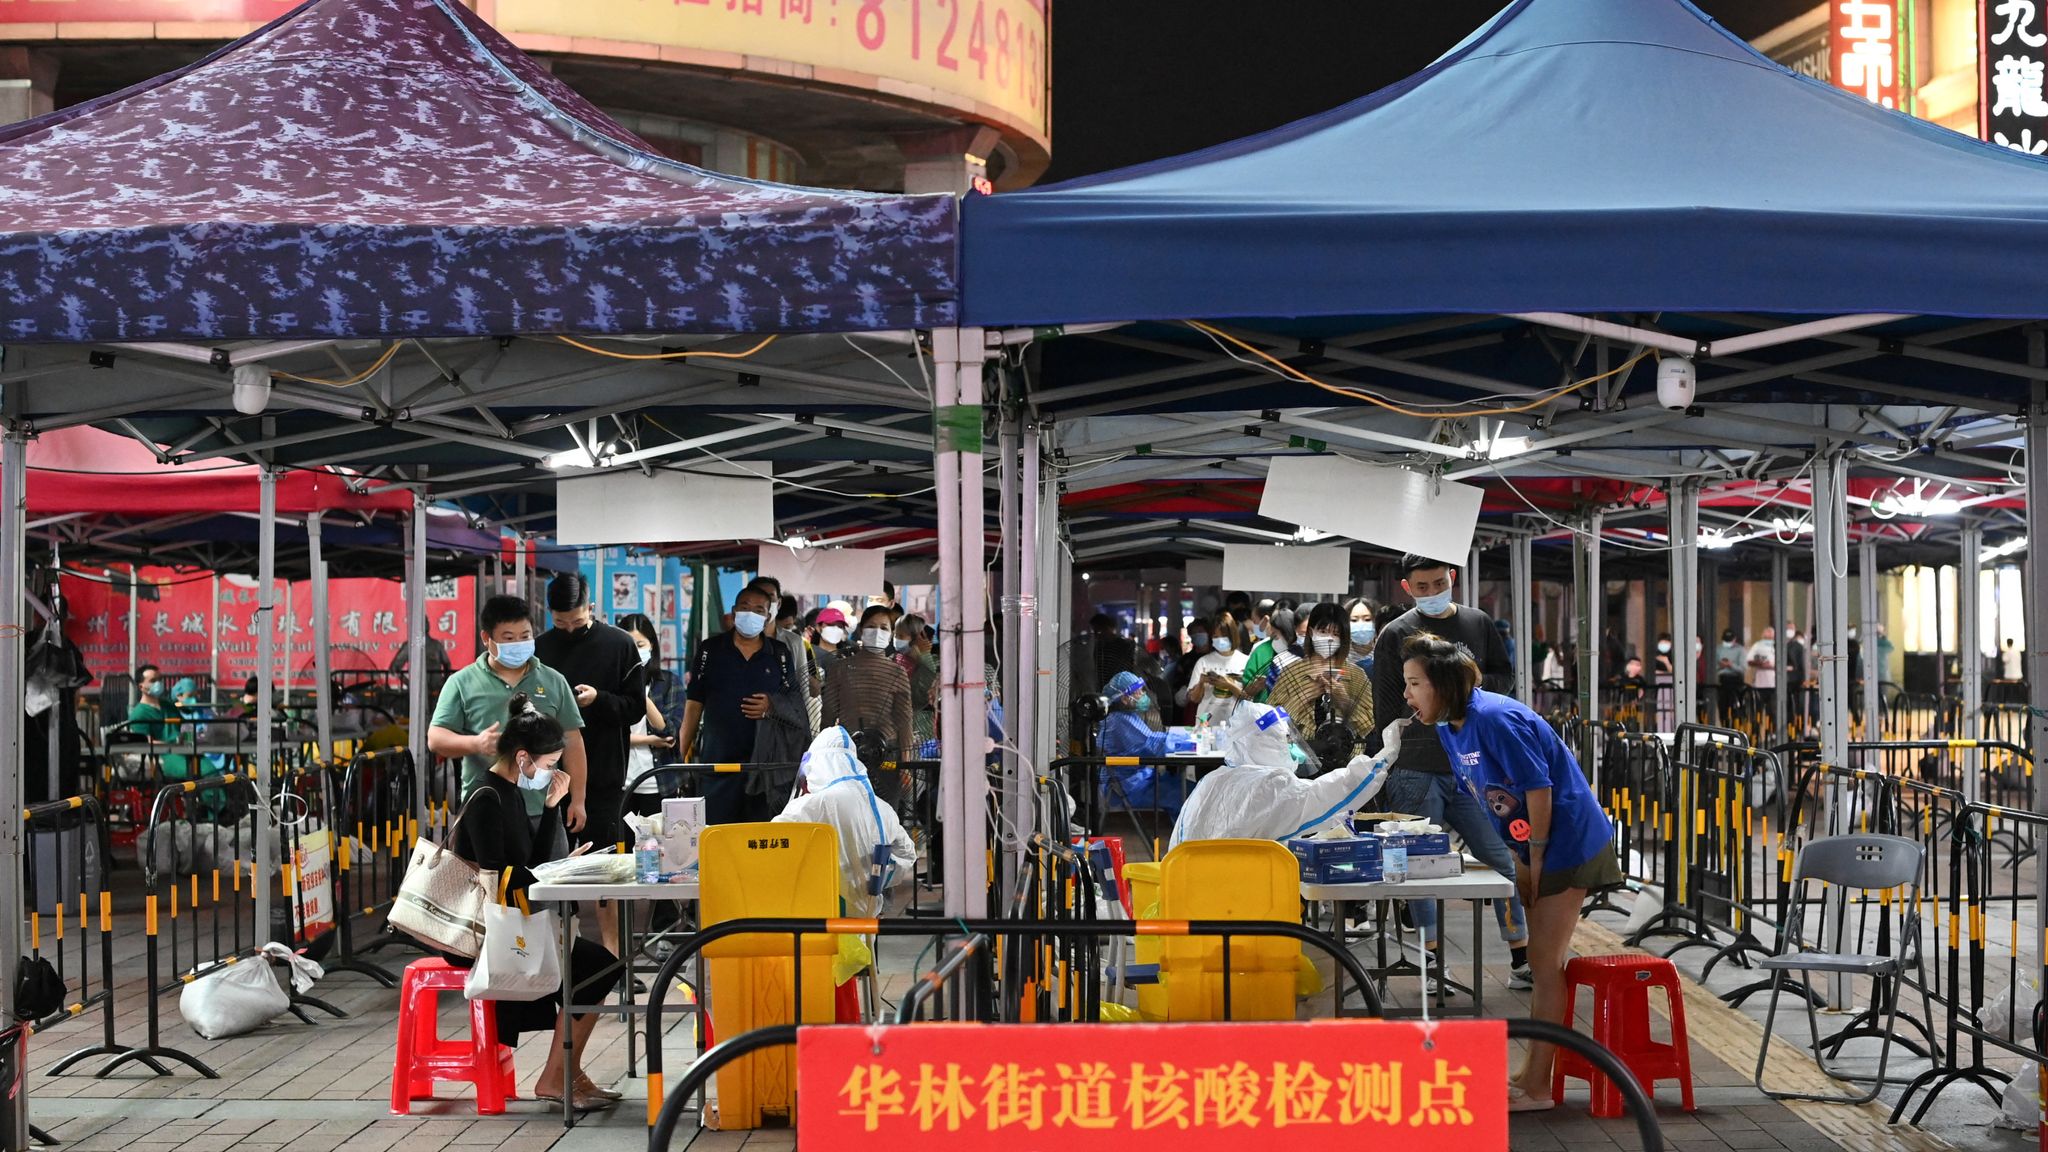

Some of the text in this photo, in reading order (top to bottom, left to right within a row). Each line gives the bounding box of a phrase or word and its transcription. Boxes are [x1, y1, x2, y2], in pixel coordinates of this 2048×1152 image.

[837, 1059, 1475, 1132] 华林街道核酸检测点
